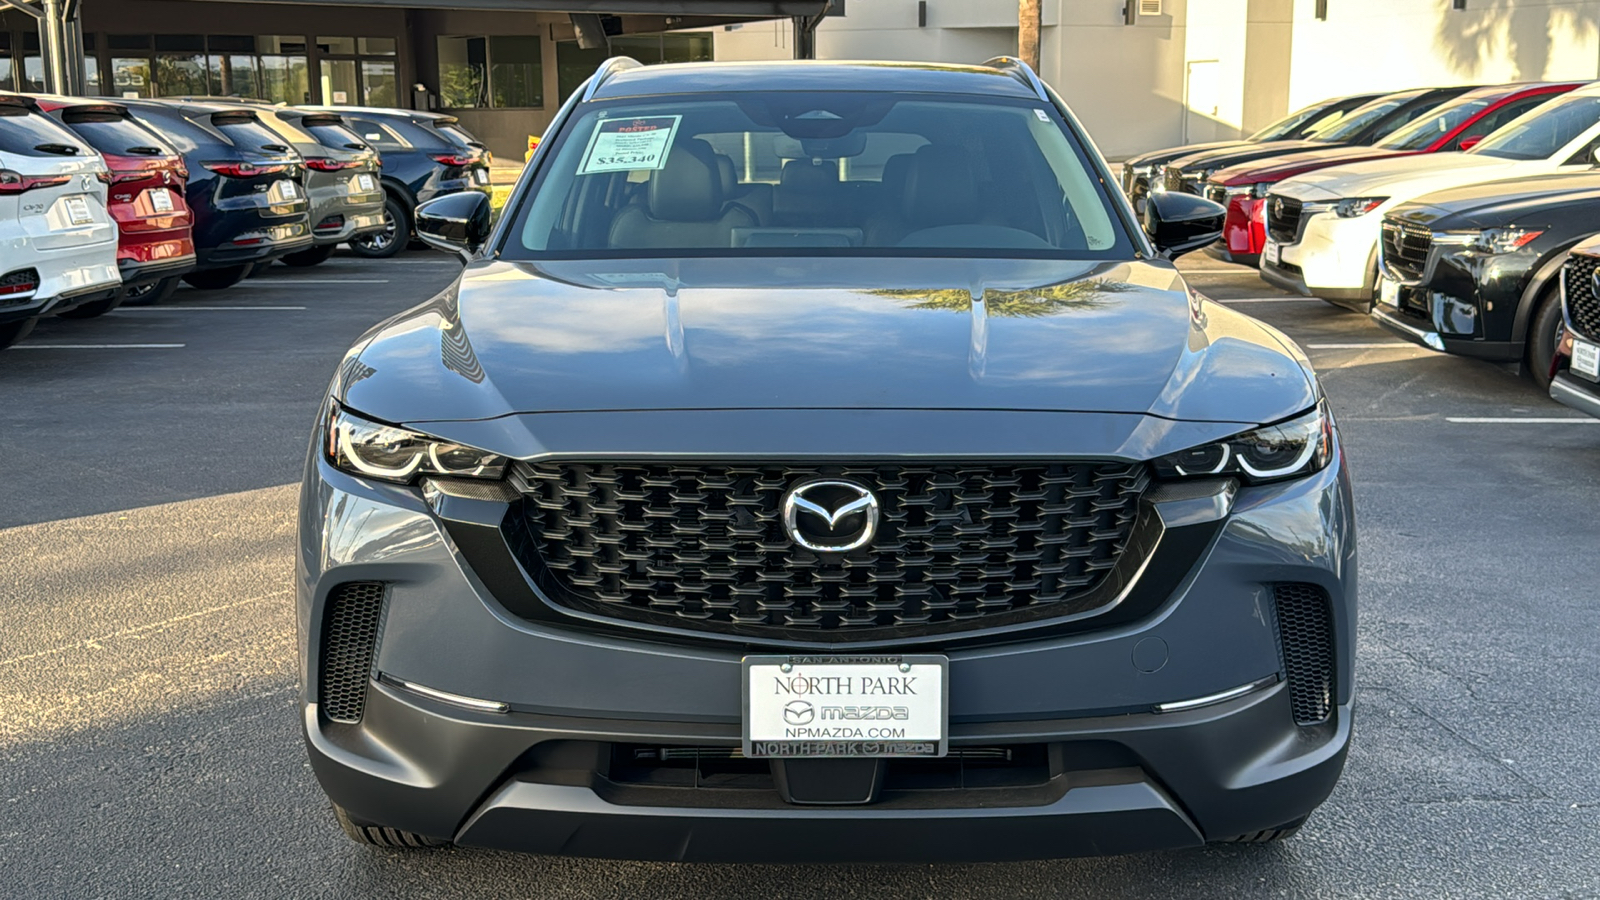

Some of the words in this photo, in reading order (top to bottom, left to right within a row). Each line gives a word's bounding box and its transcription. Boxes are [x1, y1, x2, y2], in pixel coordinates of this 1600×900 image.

[597, 154, 655, 165] $35,340
[774, 676, 852, 695] NORTH
[861, 677, 918, 695] PARK
[821, 705, 909, 720] mazda
[786, 727, 905, 738] NPMAZDA.COM
[755, 742, 811, 755] NORTH
[813, 743, 858, 755] PARK
